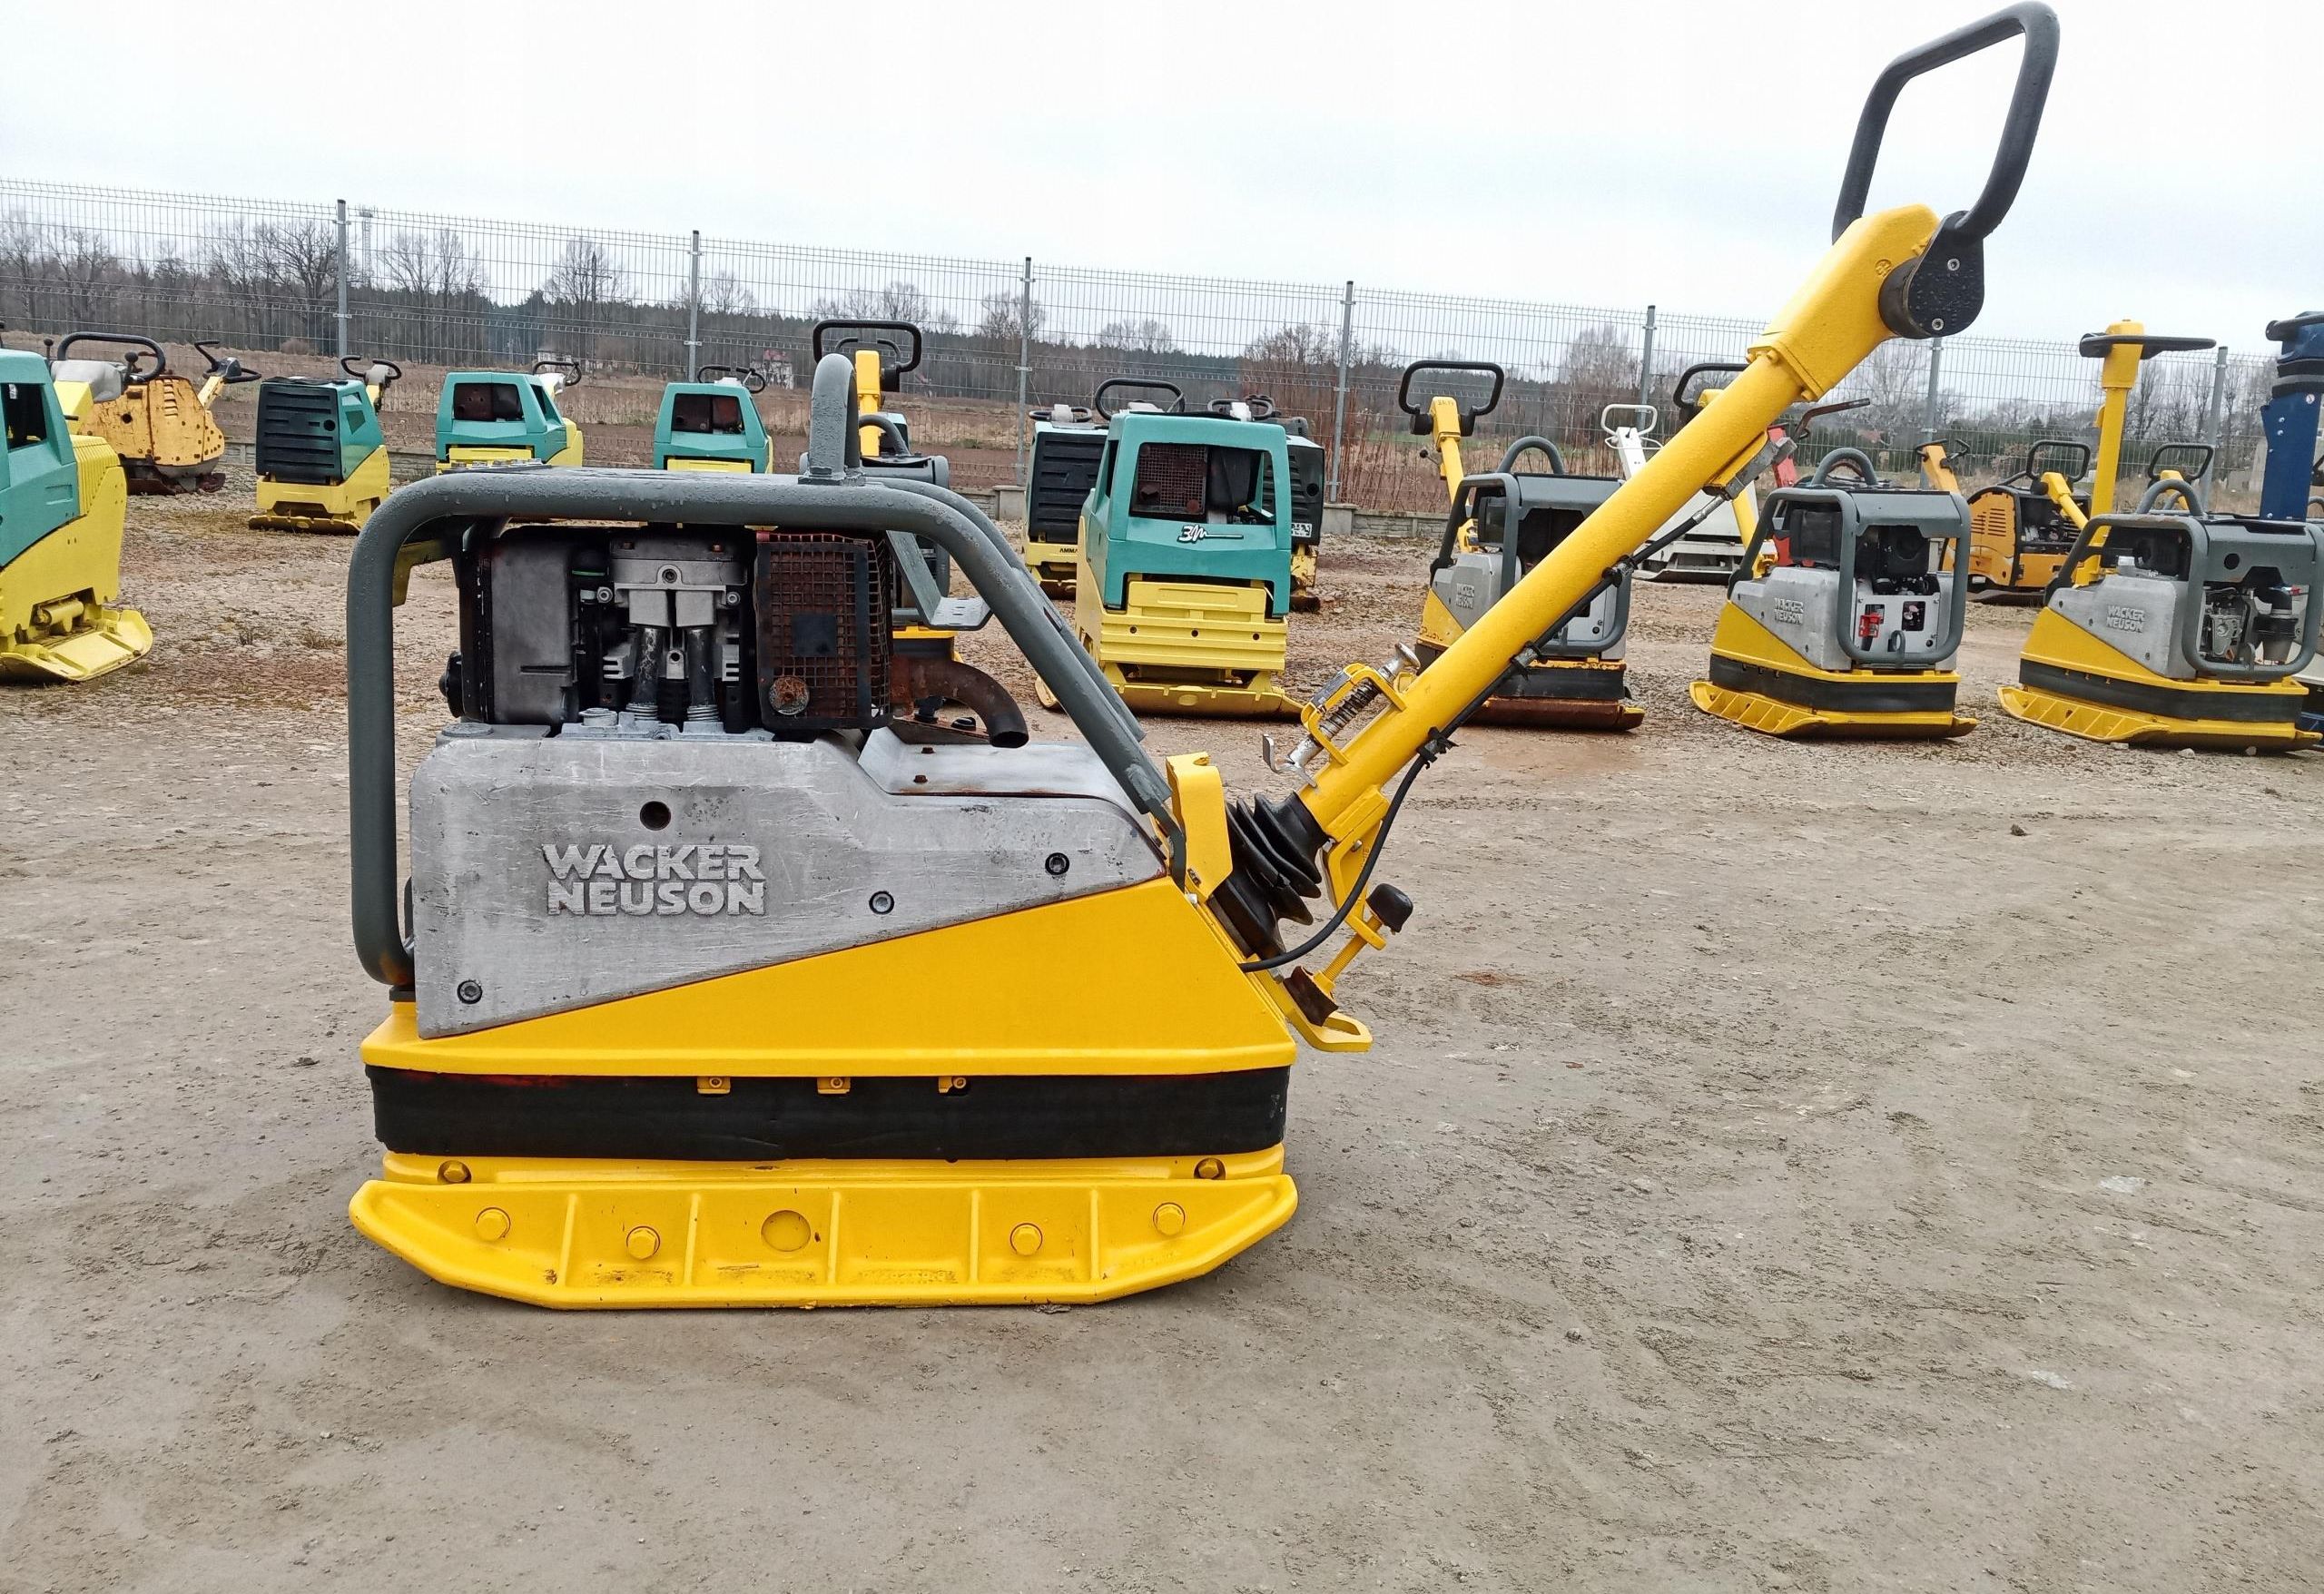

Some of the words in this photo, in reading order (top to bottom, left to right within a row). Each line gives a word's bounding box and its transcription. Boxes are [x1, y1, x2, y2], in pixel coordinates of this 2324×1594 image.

[2106, 616, 2143, 633] NEUSON
[2107, 605, 2144, 622] WACKER
[542, 843, 766, 880] WACKER
[547, 881, 766, 916] NEUSON
